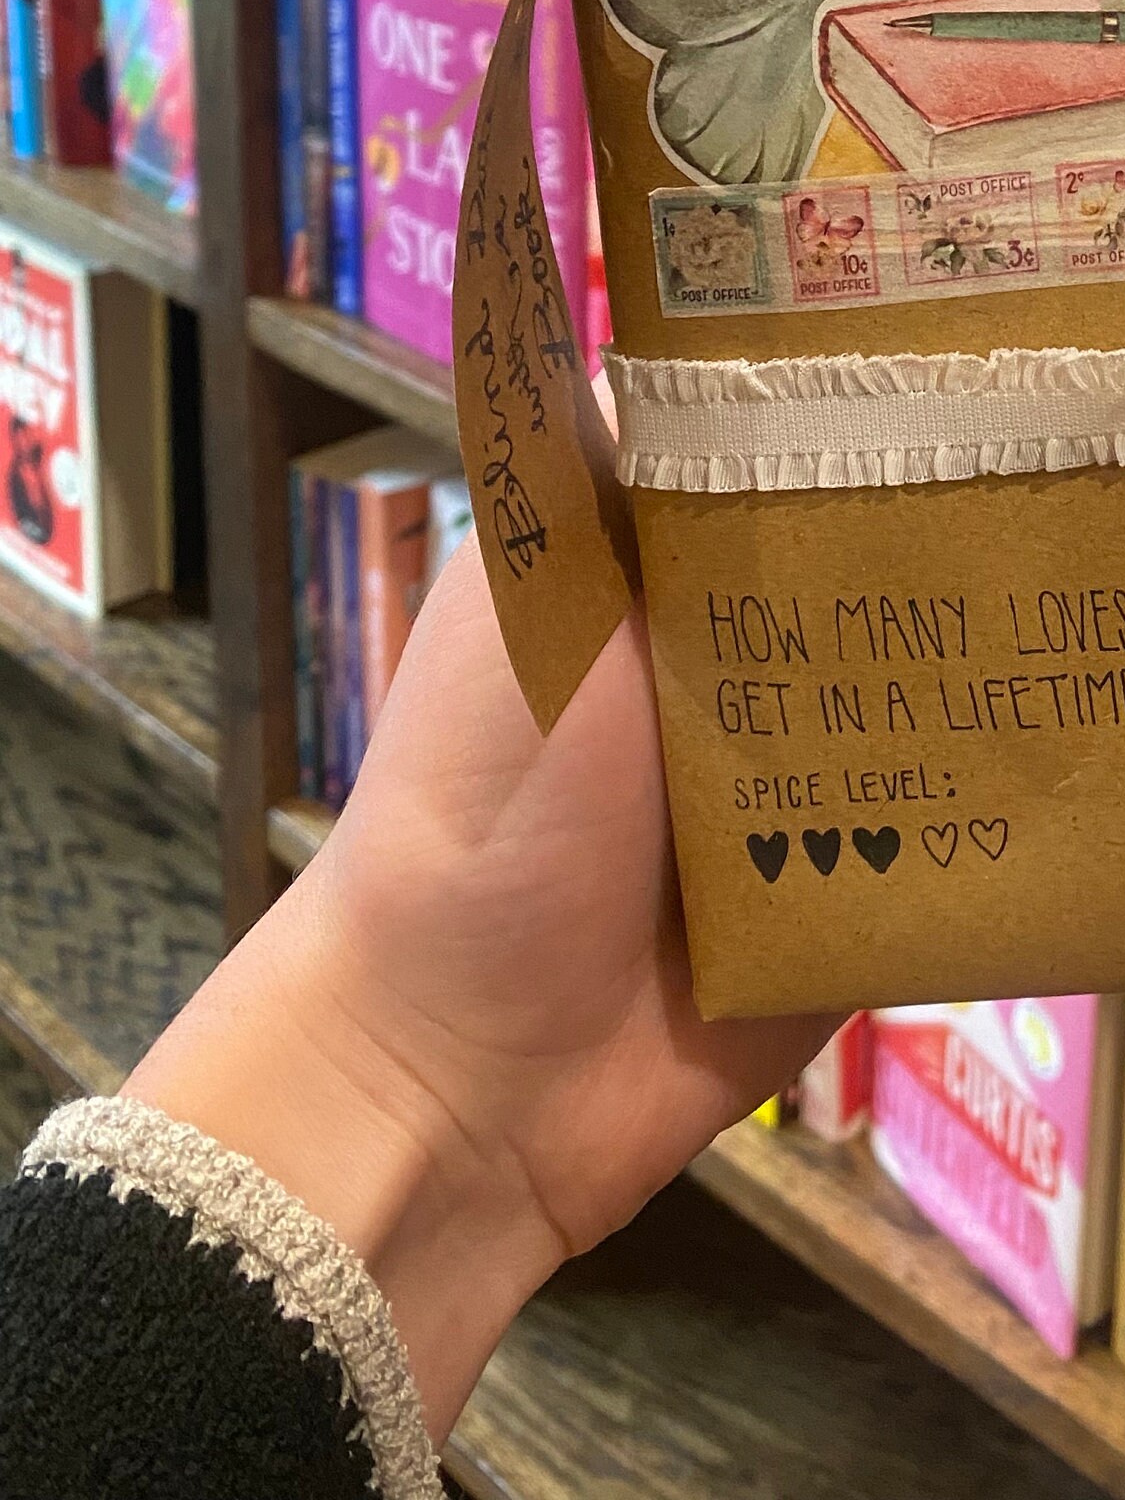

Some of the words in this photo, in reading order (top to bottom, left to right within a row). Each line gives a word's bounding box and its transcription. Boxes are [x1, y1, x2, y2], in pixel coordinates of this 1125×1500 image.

[368, 1, 457, 94] ONE
[404, 107, 465, 194] LA
[938, 181, 976, 200] POST
[978, 174, 1028, 195] OFFICE
[386, 204, 454, 298] STO
[513, 155, 576, 380] Book
[839, 254, 869, 276] 10¢
[1006, 239, 1036, 271] 3¢
[1072, 252, 1103, 267] POST
[680, 288, 708, 303] POST
[712, 285, 752, 302] OFFICE
[800, 280, 829, 296] POST
[832, 276, 873, 293] OFFICE
[465, 297, 547, 581] Blind
[707, 590, 810, 663] HOW
[835, 593, 967, 662] MANY
[715, 677, 793, 735] GET
[819, 683, 866, 735] IN
[886, 680, 916, 733] A
[734, 772, 824, 810] SPICE
[843, 762, 957, 804] LEVEL:
